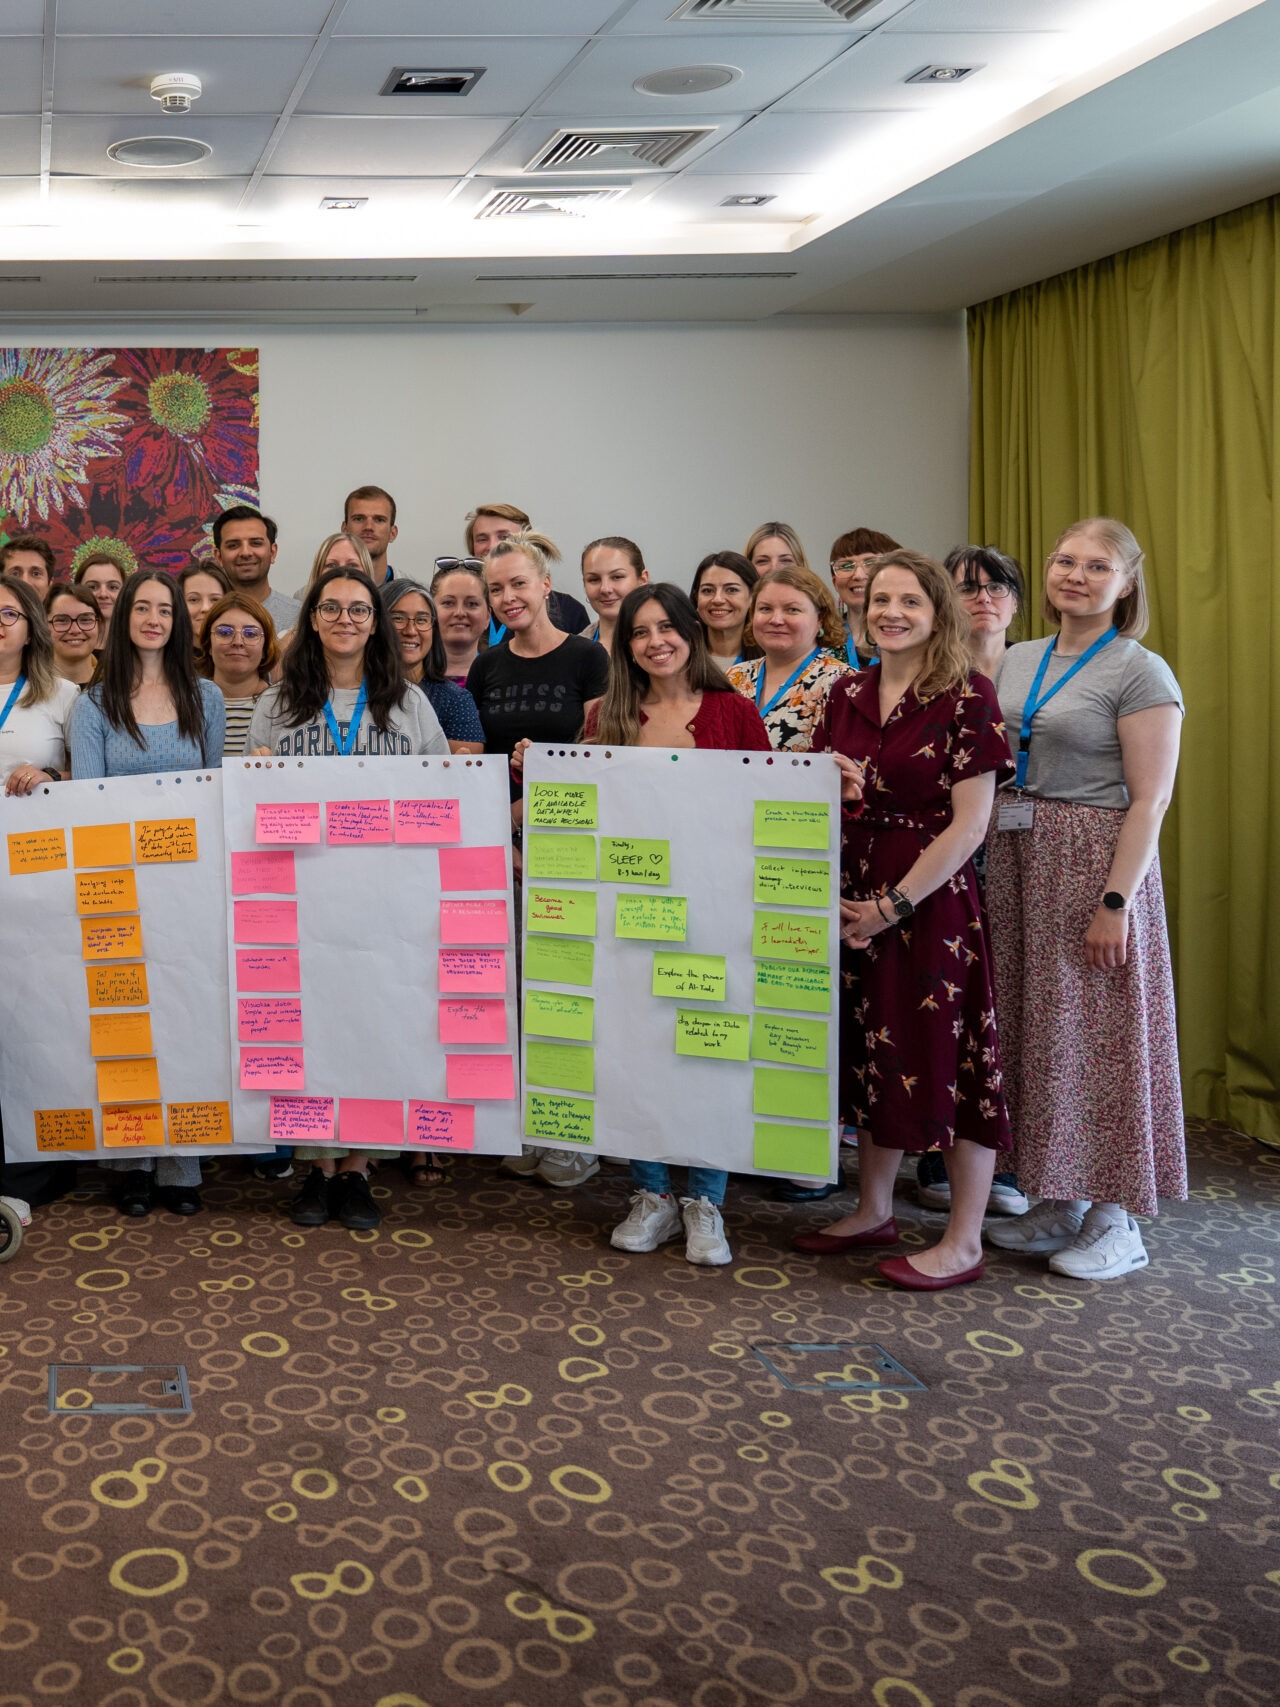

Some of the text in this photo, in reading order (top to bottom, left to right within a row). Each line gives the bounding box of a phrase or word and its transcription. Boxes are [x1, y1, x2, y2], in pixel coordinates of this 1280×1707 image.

[534, 785, 584, 799] LOOK MORE
[560, 817, 594, 825] DECISIONS
[608, 853, 643, 865] SLEEP
[761, 864, 784, 872] collect
[534, 894, 563, 903] Become
[687, 969, 699, 978] the
[675, 982, 684, 991] of
